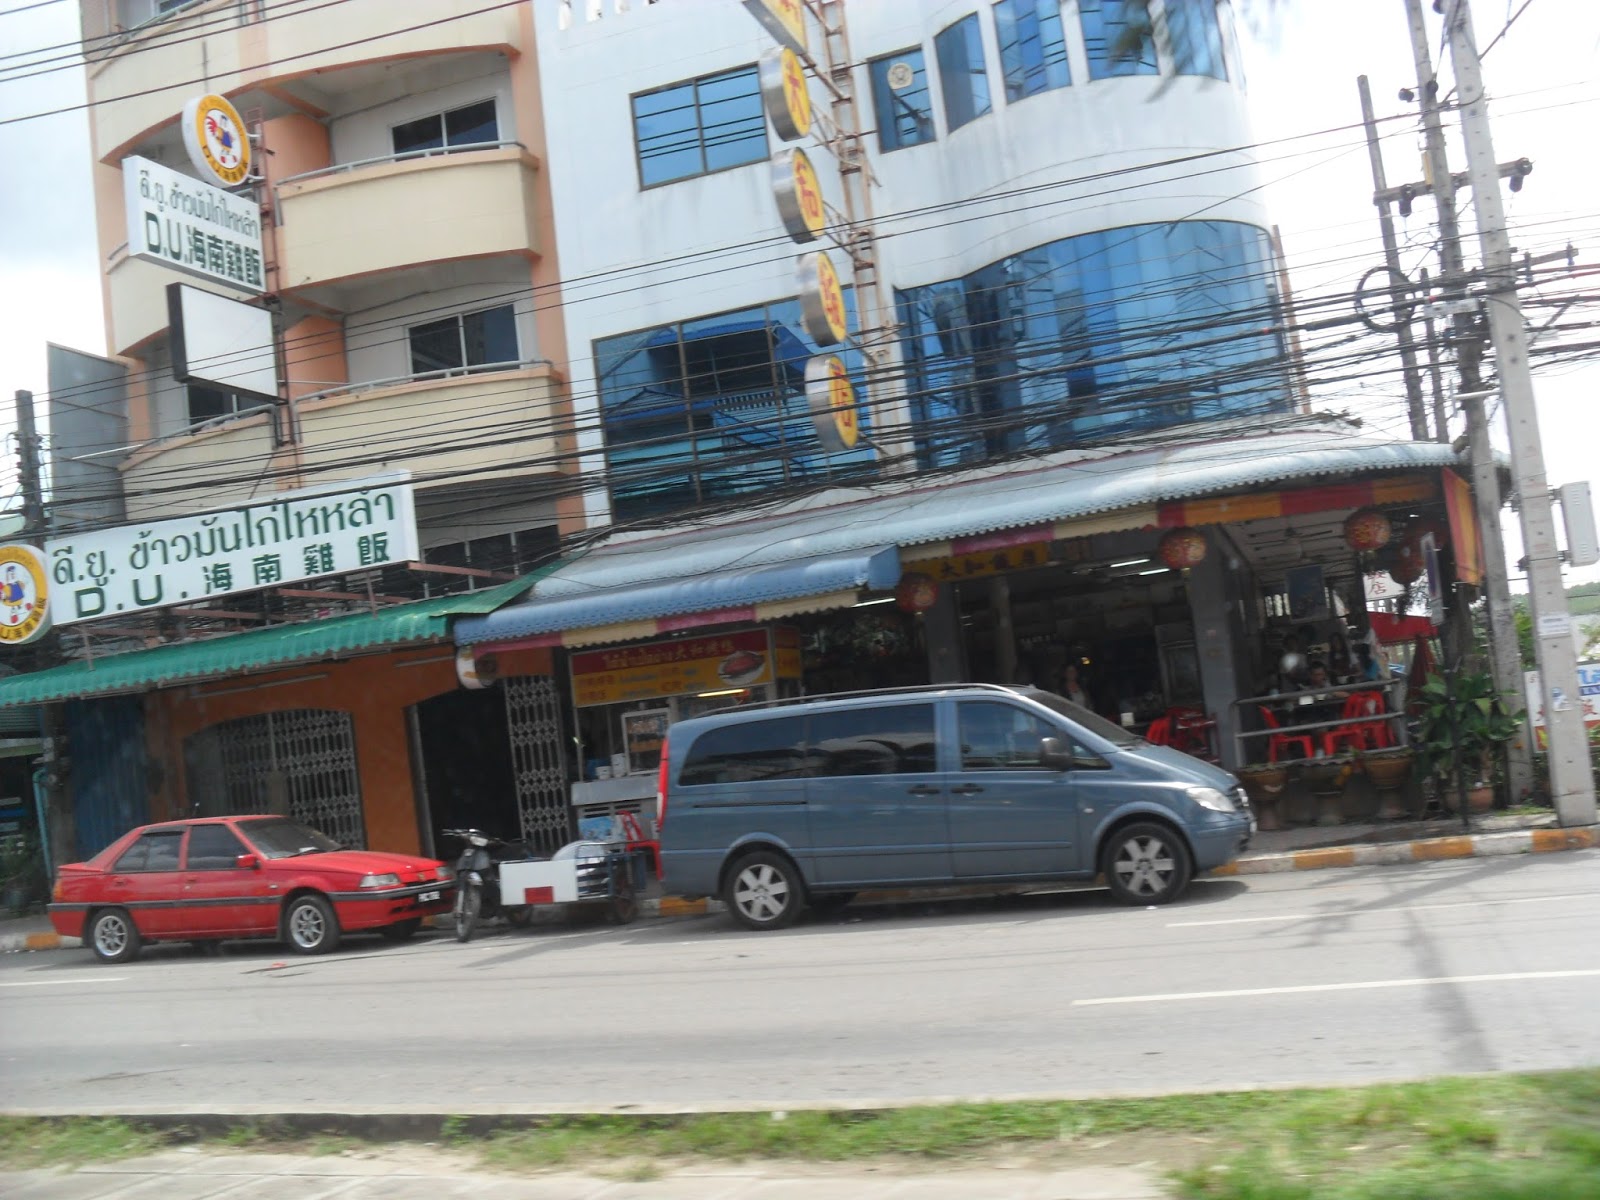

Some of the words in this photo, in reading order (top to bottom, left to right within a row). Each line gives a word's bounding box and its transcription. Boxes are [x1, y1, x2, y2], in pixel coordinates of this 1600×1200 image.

[145, 210, 188, 264] D.U.
[202, 531, 391, 595] 海南雞飯
